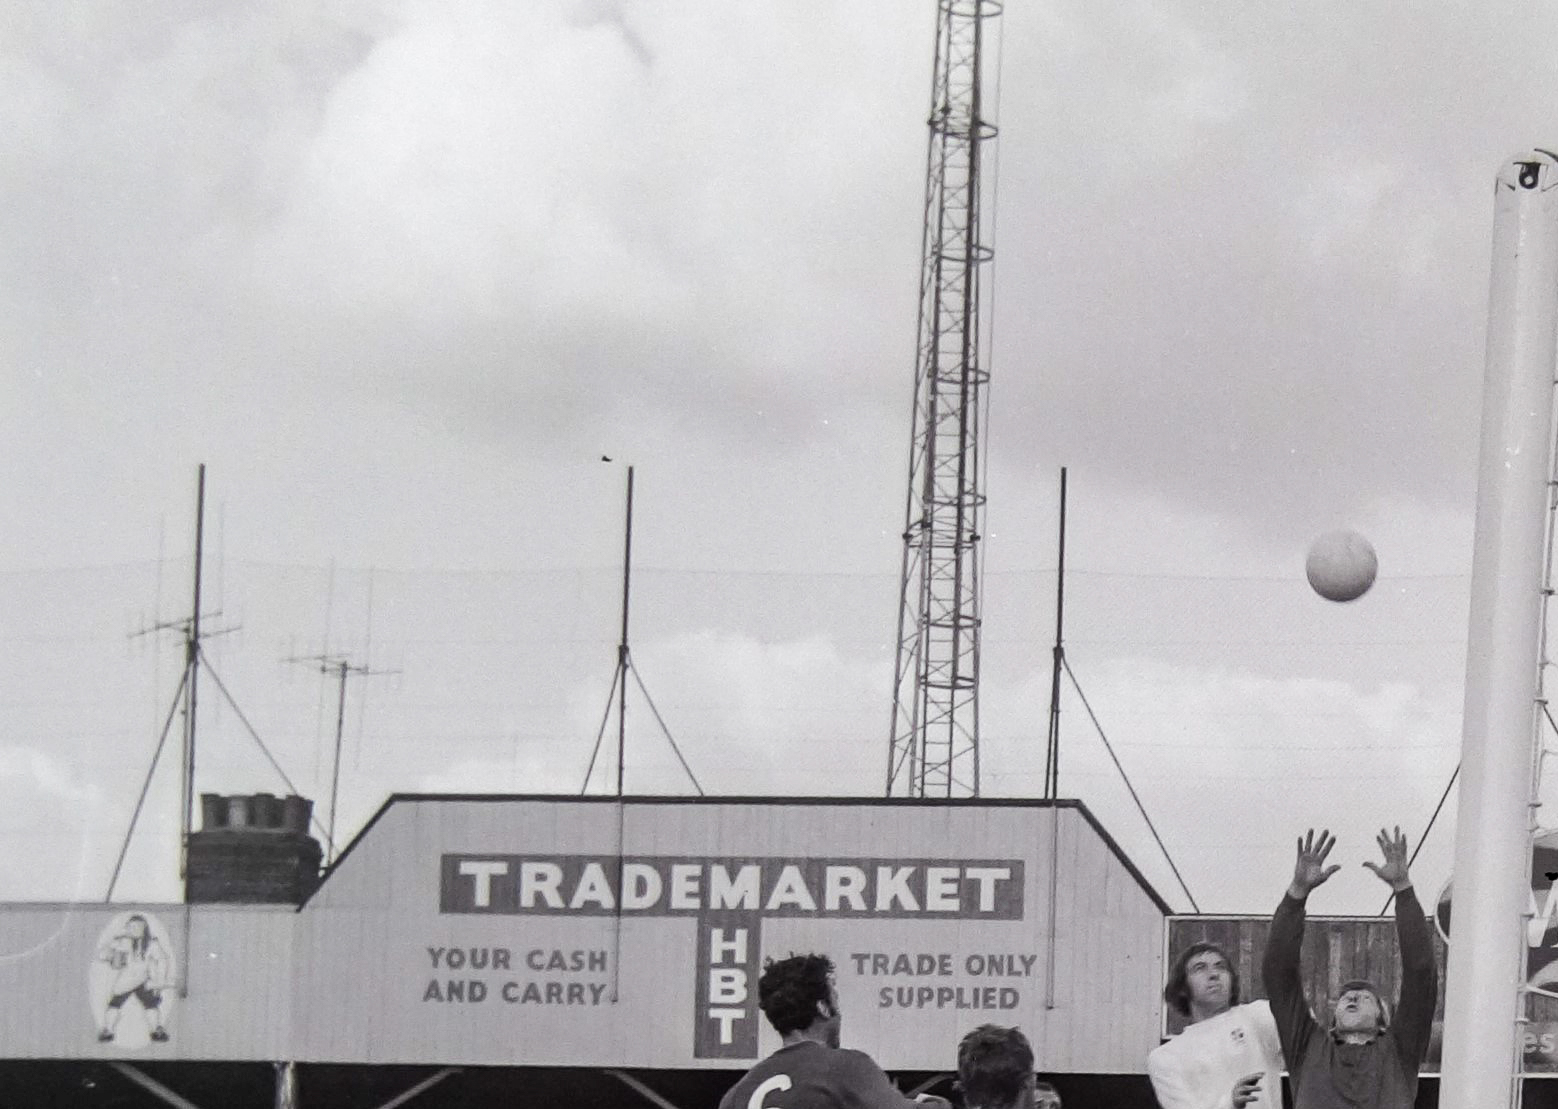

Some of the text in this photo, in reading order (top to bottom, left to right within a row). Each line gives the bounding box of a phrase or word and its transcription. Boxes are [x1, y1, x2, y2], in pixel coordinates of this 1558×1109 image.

[458, 861, 1012, 913] TRADEMARKET
[426, 947, 608, 972] YOUR CASH
[851, 953, 1037, 977] TRADE ONLY
[422, 978, 607, 1006] AND CARRY
[709, 928, 748, 1045] HBT
[878, 986, 1021, 1010] SUPPLIED
